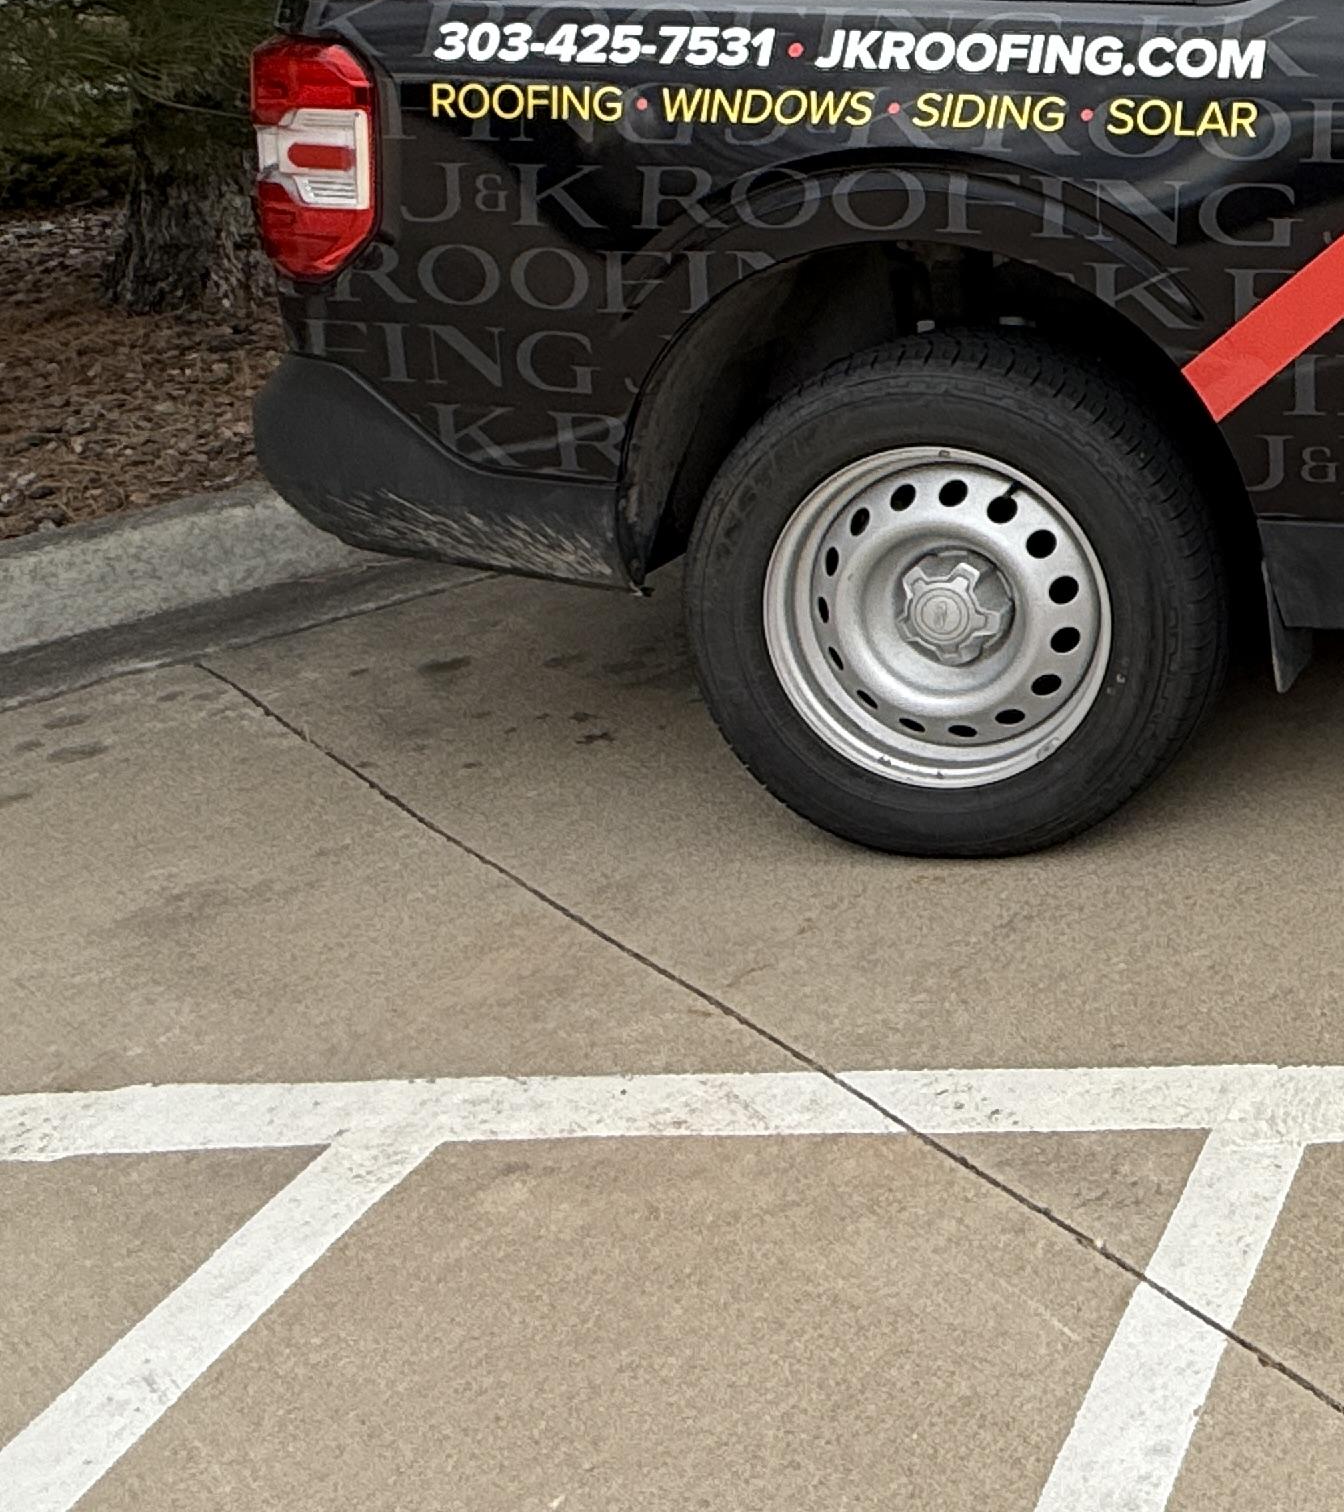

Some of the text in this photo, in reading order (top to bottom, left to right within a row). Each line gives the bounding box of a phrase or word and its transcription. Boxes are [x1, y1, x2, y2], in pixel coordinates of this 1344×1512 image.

[433, 21, 778, 69] 303-425-7531
[814, 28, 1267, 80] JKROOFING.COM
[431, 82, 625, 124] ROOFING
[662, 88, 876, 126] WINDOWS
[912, 92, 1067, 134] SIDING
[1106, 95, 1258, 139] SOLAR
